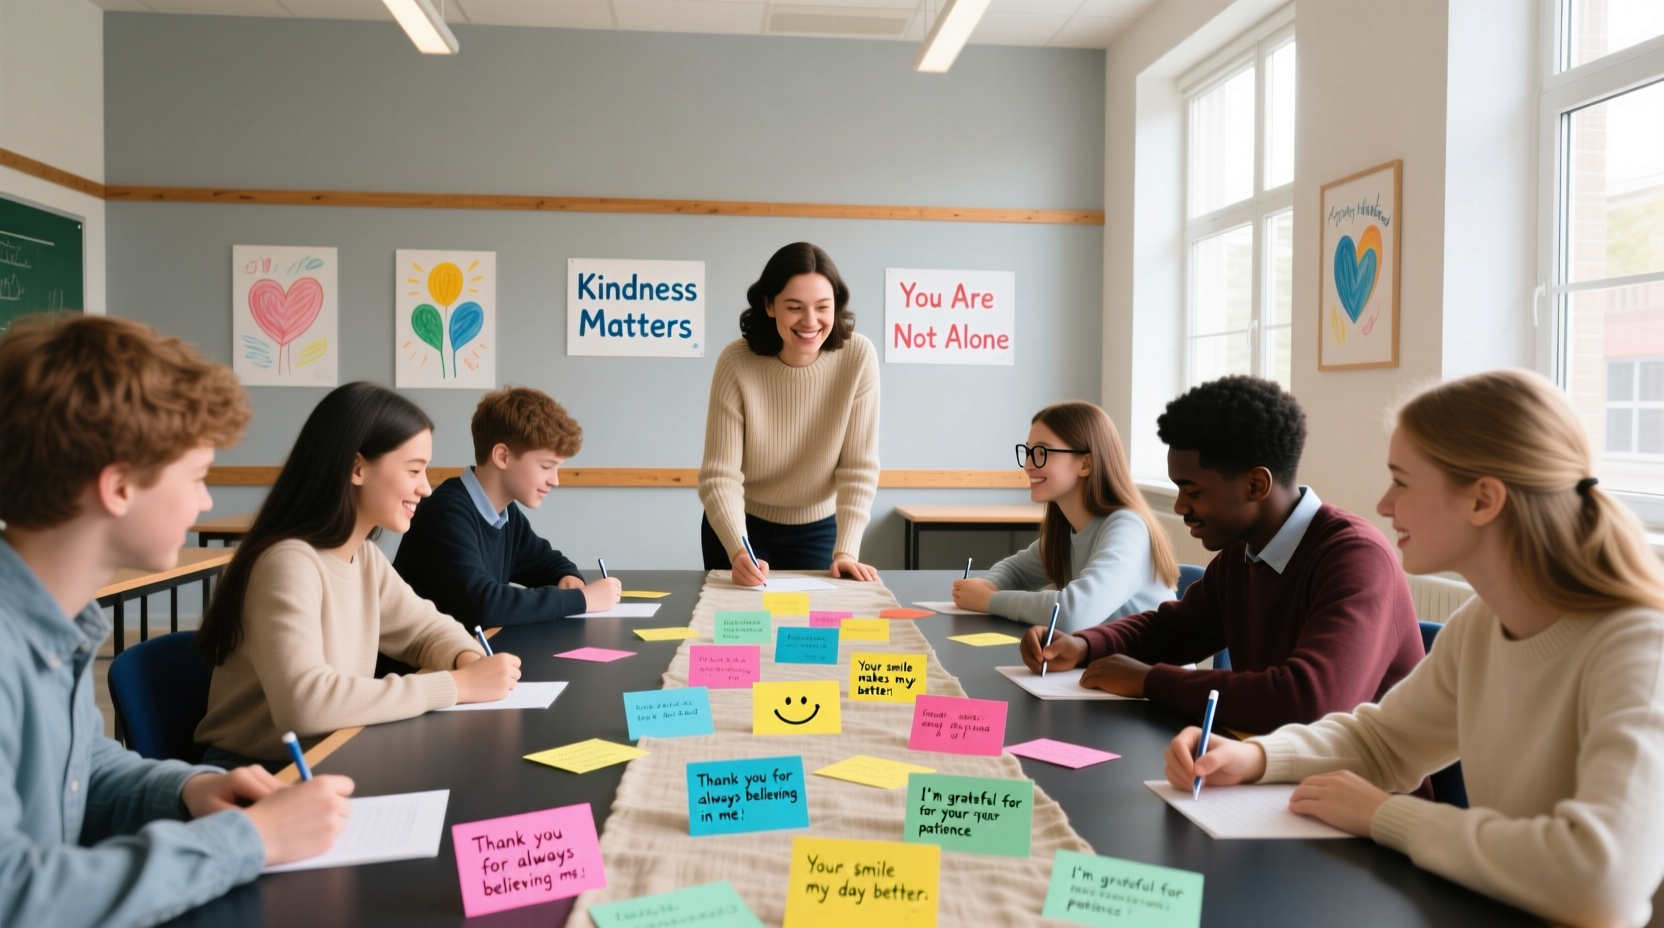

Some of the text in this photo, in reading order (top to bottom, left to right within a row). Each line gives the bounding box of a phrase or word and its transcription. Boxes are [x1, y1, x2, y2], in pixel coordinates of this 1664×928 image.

[578, 272, 697, 302] Kindness
[899, 281, 994, 309] You Are
[579, 308, 692, 339] Matters
[894, 323, 1009, 350] Not Alone
[858, 659, 913, 672] Your smile
[696, 768, 793, 789] Thank you for
[921, 786, 942, 802] I'm
[1001, 794, 1023, 808] for
[701, 810, 713, 822] in
[919, 805, 937, 816] for
[941, 809, 969, 823] your
[471, 829, 562, 853] Thank you
[919, 822, 972, 837] patience
[481, 848, 574, 876] for always
[807, 854, 895, 878] Your smile
[482, 873, 552, 896] believing
[806, 883, 829, 904] my
[838, 879, 866, 905] day
[1161, 882, 1184, 898] for
